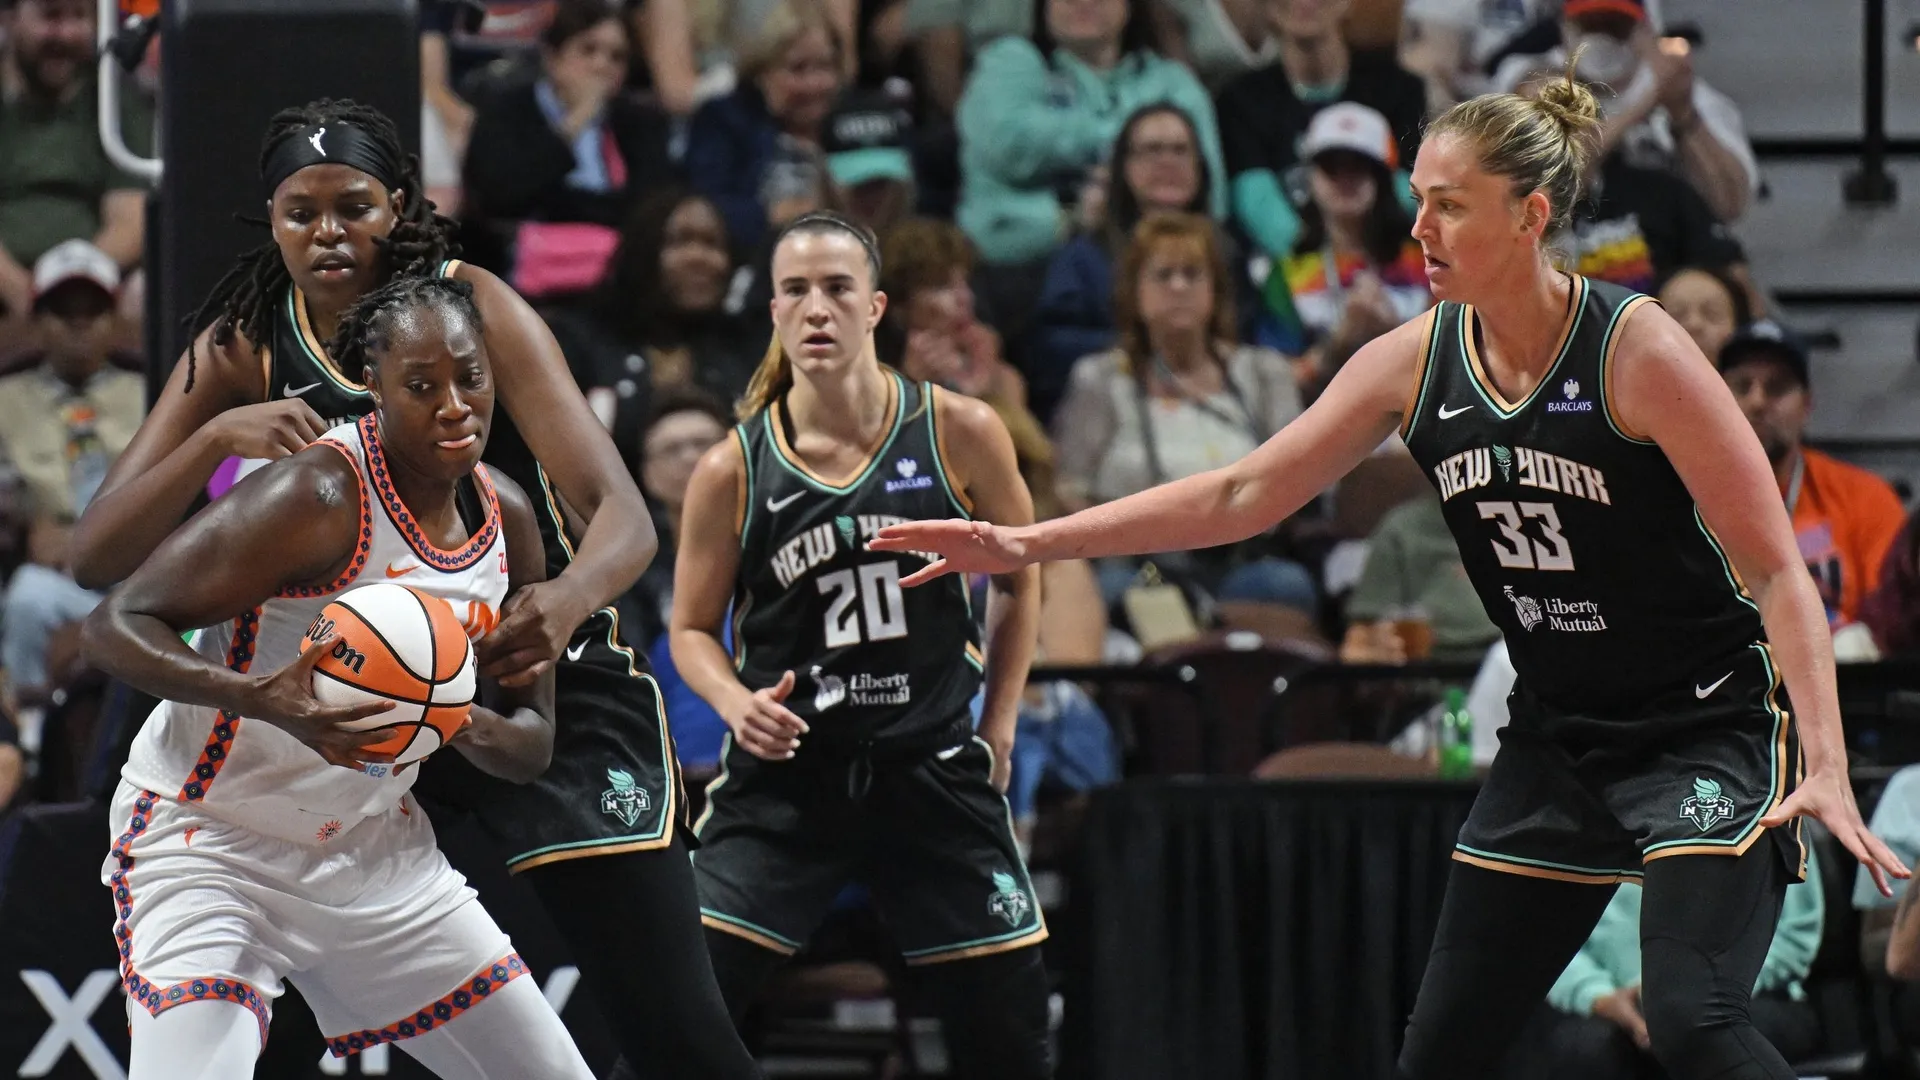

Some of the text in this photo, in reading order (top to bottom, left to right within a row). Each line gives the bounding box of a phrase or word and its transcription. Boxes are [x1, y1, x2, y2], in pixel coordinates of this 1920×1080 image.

[1548, 401, 1592, 412] BARCLAYS
[885, 476, 933, 493] BARCLAYS
[1434, 446, 1612, 506] NEW YORK
[1475, 501, 1576, 571] 33
[770, 521, 837, 590] NEW
[815, 560, 909, 649] 20
[1544, 598, 1599, 620] Liberty
[1549, 615, 1609, 632] Mutual
[305, 611, 366, 676] Wilon
[850, 672, 910, 692] Liberty
[850, 686, 911, 706] Mutual
